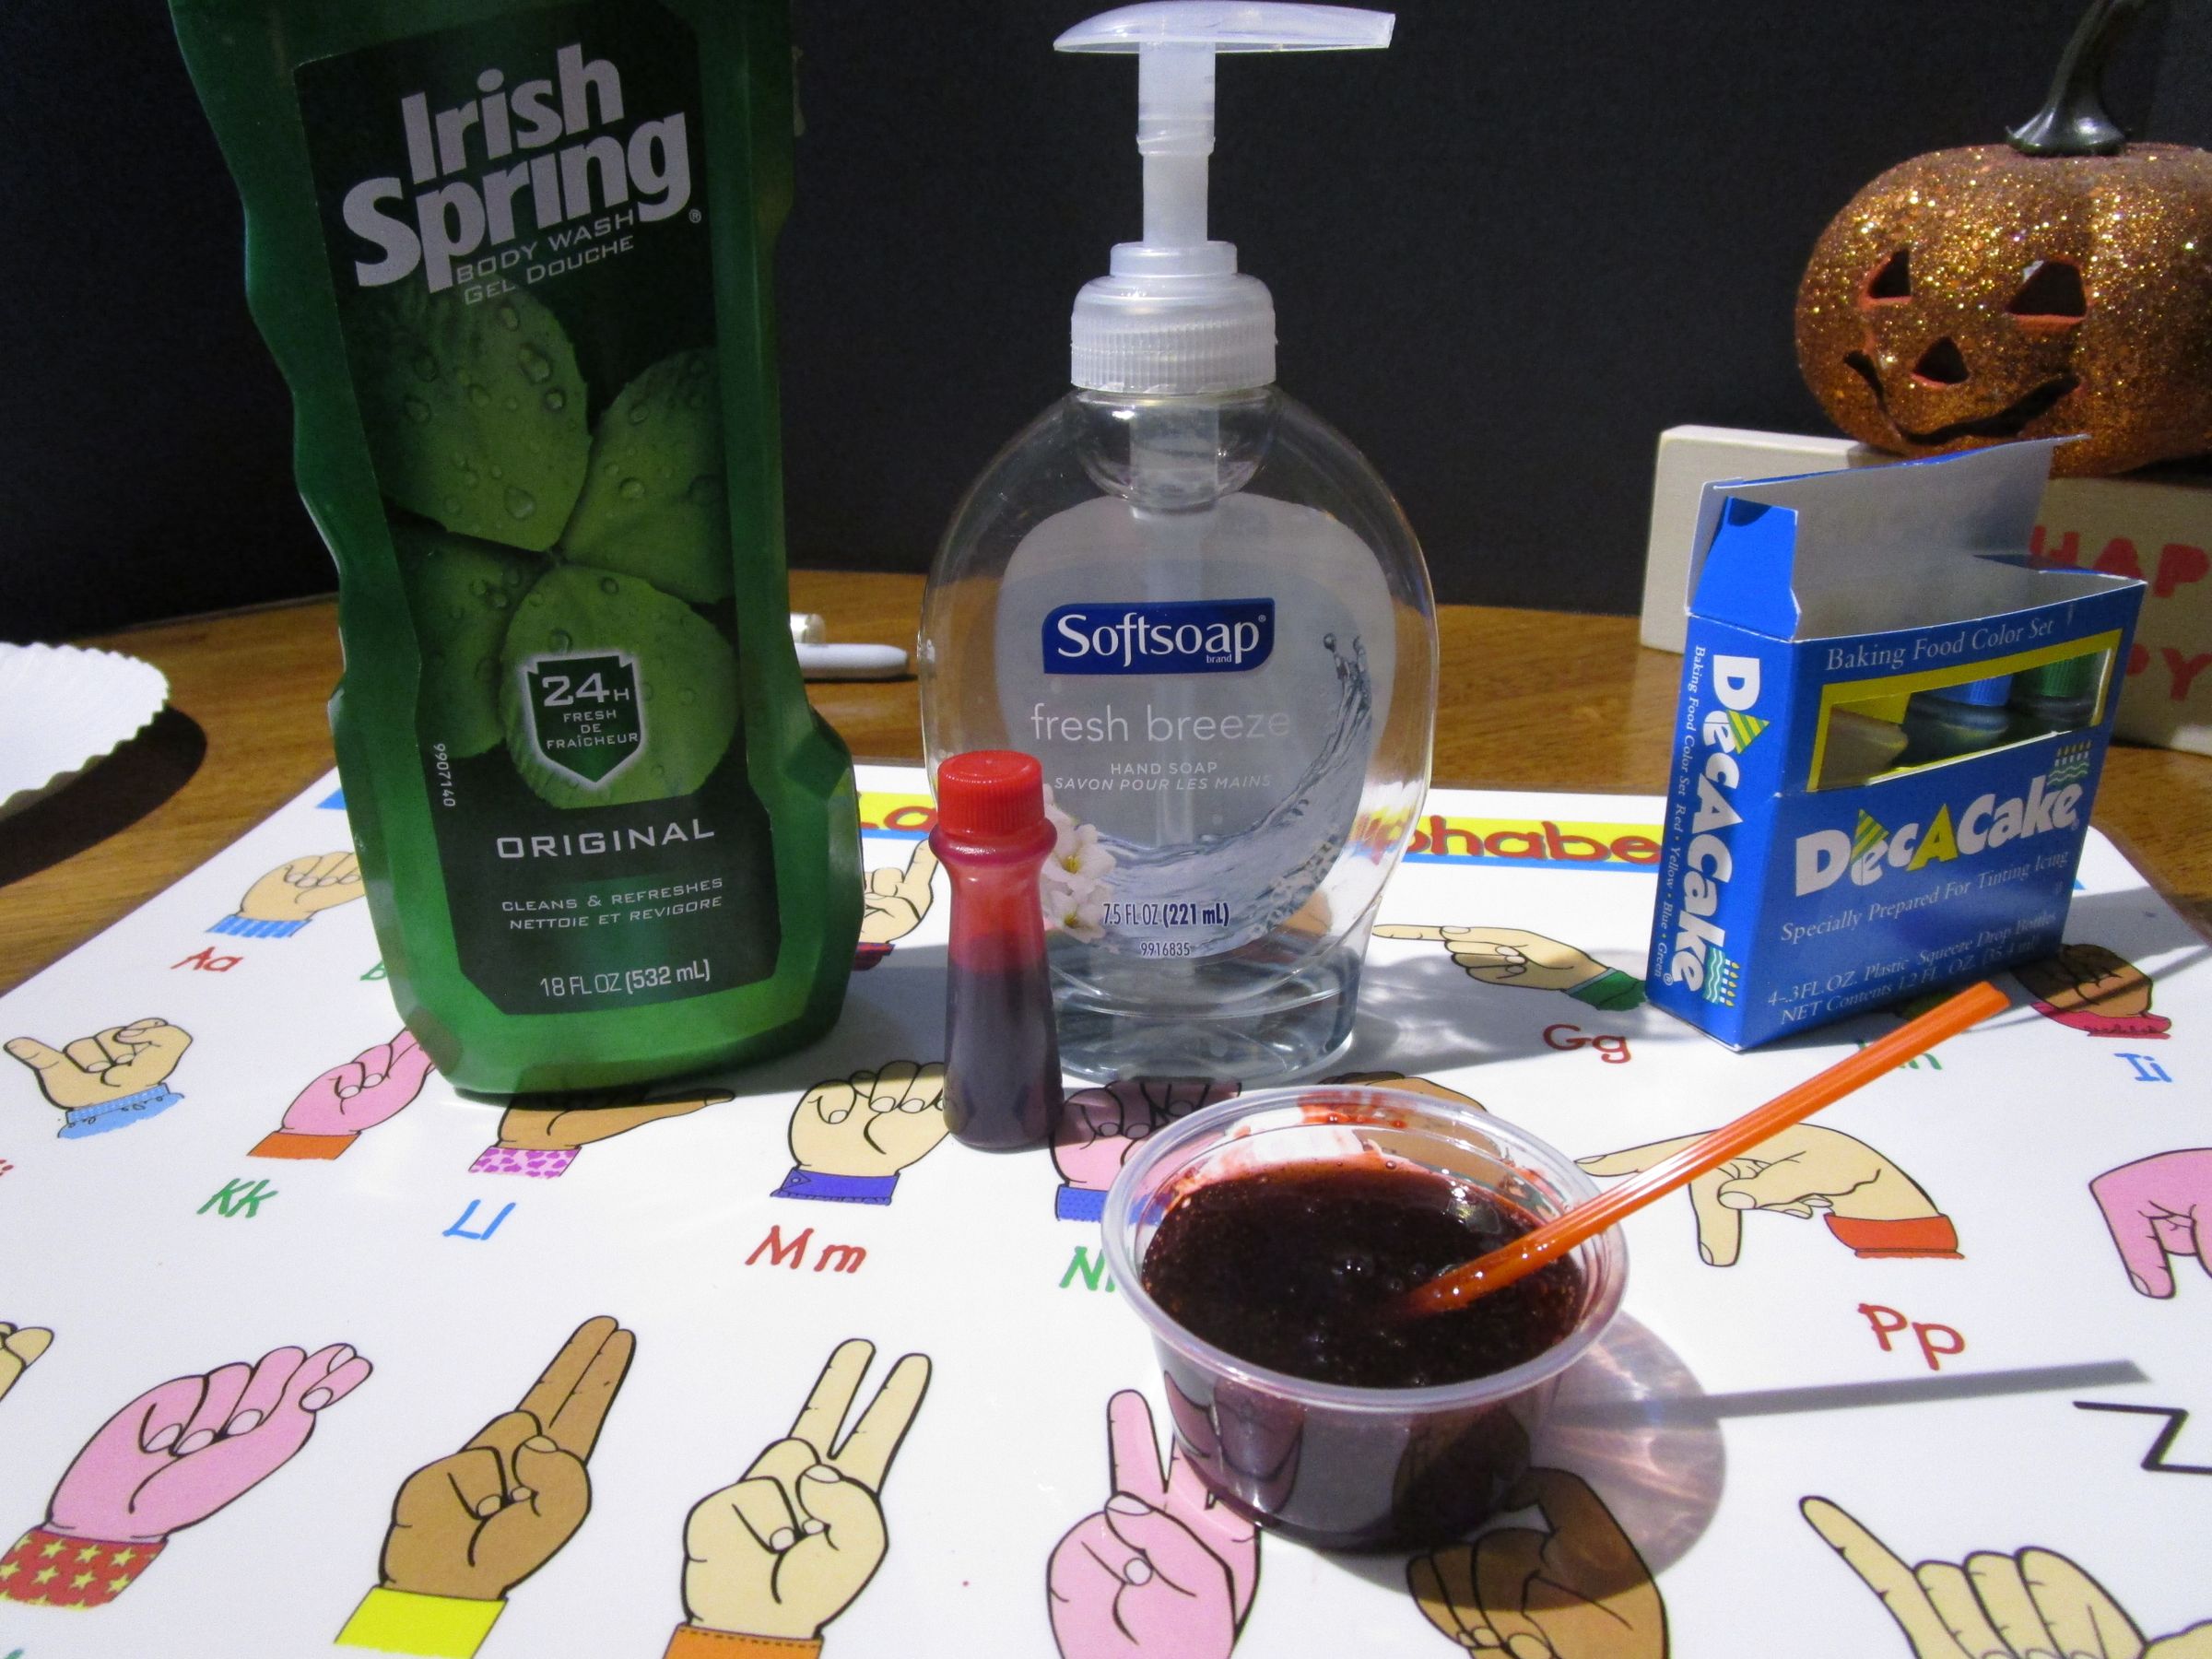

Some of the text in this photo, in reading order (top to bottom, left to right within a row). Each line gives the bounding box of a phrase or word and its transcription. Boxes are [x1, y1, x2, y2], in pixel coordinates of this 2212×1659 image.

[402, 42, 624, 184] Irish
[343, 112, 691, 294] Spring
[456, 208, 634, 284] BODY WASH
[464, 234, 635, 305] GEL DOUCHE
[1057, 612, 1260, 667] Softsoap
[1206, 653, 1232, 665] brand
[1825, 617, 2054, 671] Baking Food Color Set
[562, 709, 618, 724] FRESH
[580, 723, 602, 735] DE
[1030, 703, 1290, 742] fresh breeze
[433, 743, 456, 807] 9907140
[1053, 774, 1272, 791] SAVON POUR LES MAINS
[1111, 761, 1218, 775] HAND SOAP
[1653, 644, 1705, 978] Baking Food Color Set Red Yellow Blue Green
[497, 818, 715, 859] ORIGINAL
[501, 877, 724, 912] CLEANS & REFRESHES
[510, 896, 723, 930] NETTOIE ET REVIGORE
[1125, 903, 1139, 925] FL
[1142, 903, 1159, 925] OZ
[1162, 902, 1197, 928] (221
[1202, 901, 1230, 927] mL)
[1780, 850, 2070, 946] Specially Prepared For Tinting Icing
[171, 947, 244, 973] Aa
[1140, 942, 1191, 957] 9916835
[539, 958, 711, 997] 18 FL OZ (532 mL)
[1864, 959, 1910, 982] Plastic
[1780, 1000, 1824, 1026] NET
[1826, 982, 1893, 1012] Contents
[1542, 1024, 1631, 1065] Gg
[1059, 1245, 1115, 1292] N
[1858, 1302, 1966, 1371] Pp
